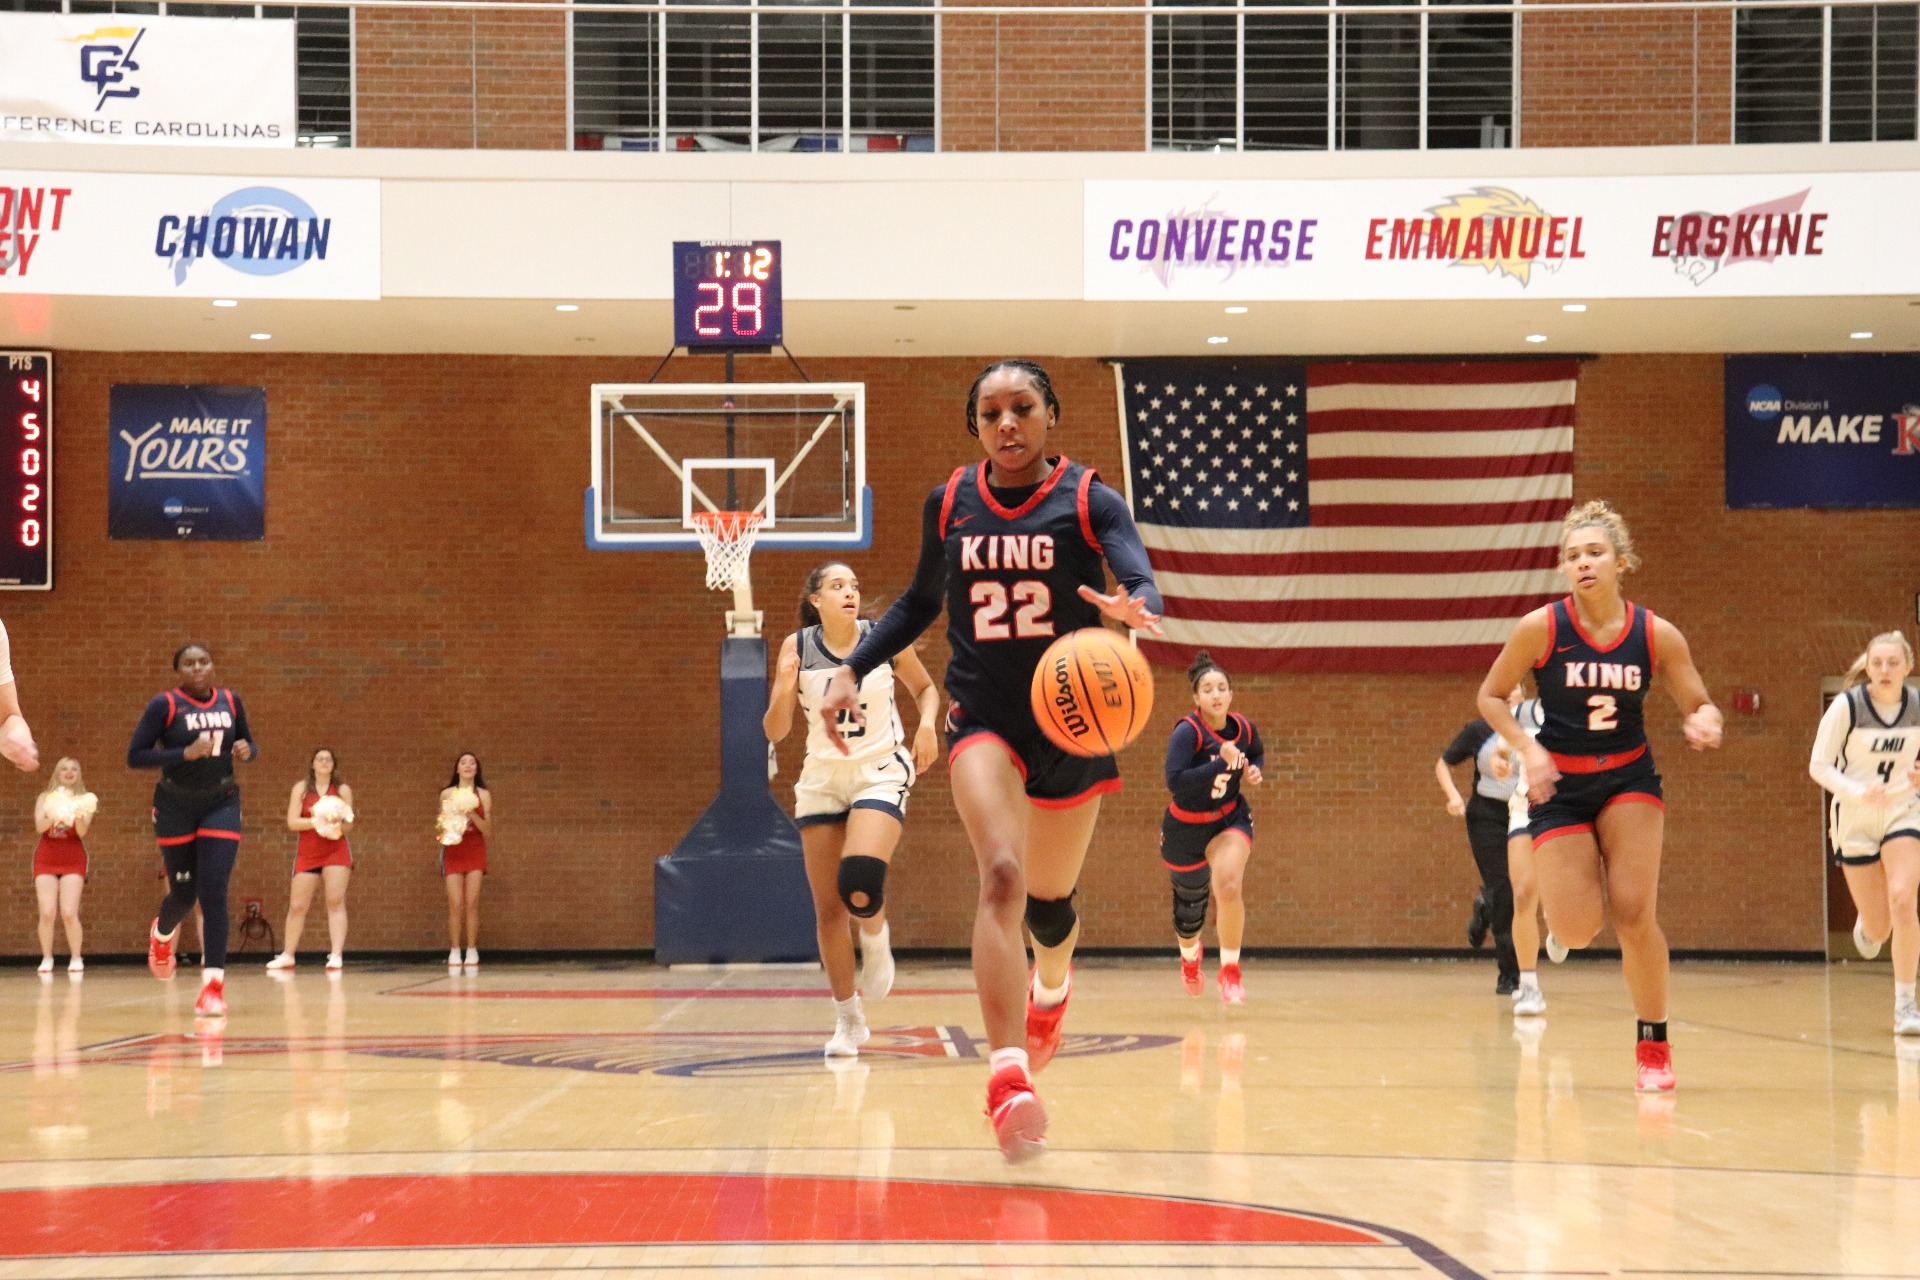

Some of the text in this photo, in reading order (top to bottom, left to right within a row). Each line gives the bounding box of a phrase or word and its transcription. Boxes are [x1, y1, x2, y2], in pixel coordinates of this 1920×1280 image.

[134, 121, 281, 138] CAROLINAS
[155, 215, 331, 260] CHOWAN
[1109, 218, 1318, 261] CONVERSE
[1365, 217, 1586, 260] EMMANUEL
[1651, 213, 1828, 258] ERSKINE
[715, 248, 772, 280] 1:12
[9, 356, 33, 370] PTS
[22, 380, 40, 402] 4
[22, 413, 40, 440] 5
[168, 417, 252, 435] MAKE IT
[1777, 415, 1884, 444] MAKE
[22, 448, 40, 475] 0
[119, 422, 249, 481] YOURS
[22, 484, 40, 511] 2
[22, 519, 40, 546] 0
[961, 534, 1055, 572] KING
[968, 579, 1056, 642] 22
[1564, 661, 1642, 691] KING
[1055, 656, 1090, 738] Wilson
[184, 711, 232, 731] KING
[1586, 694, 1620, 731] 2
[1870, 736, 1906, 753] LMU
[1210, 771, 1233, 799] 5
[1877, 760, 1895, 784] 4
